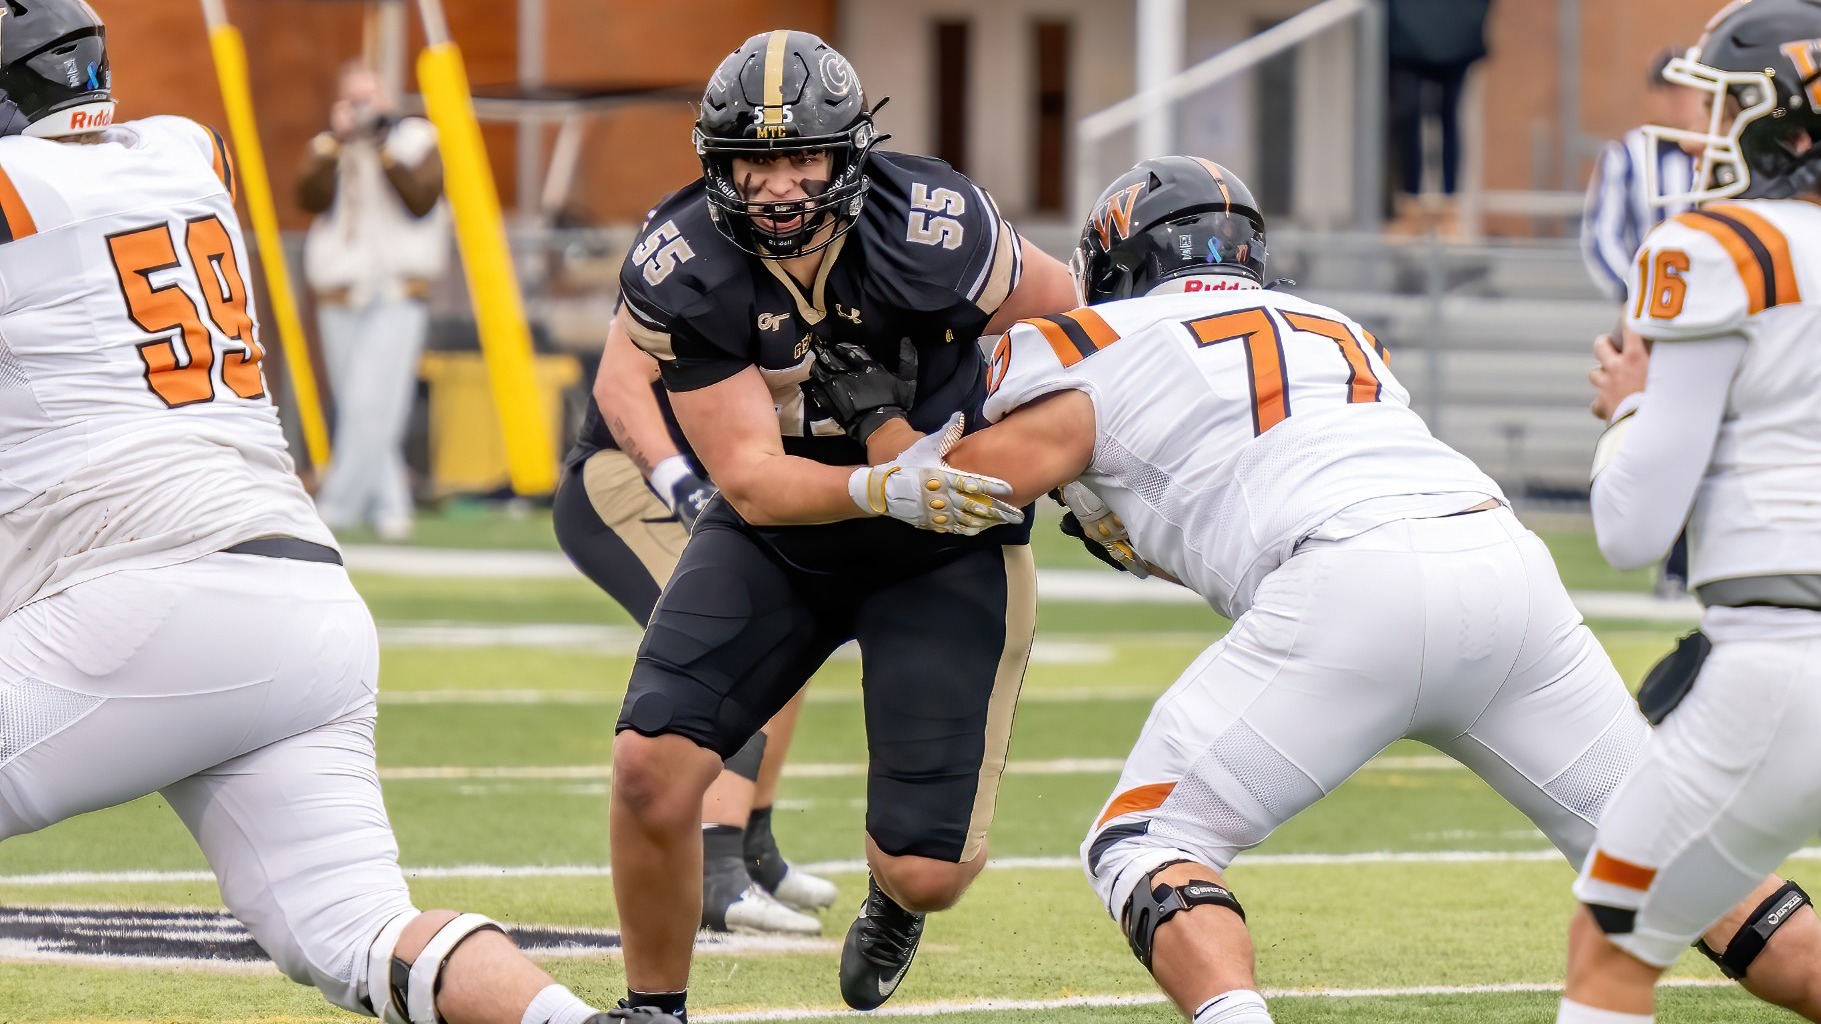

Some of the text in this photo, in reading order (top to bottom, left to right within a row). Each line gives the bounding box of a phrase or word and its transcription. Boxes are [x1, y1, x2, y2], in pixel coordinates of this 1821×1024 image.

[905, 182, 966, 251] 55
[1093, 181, 1146, 254] W
[631, 219, 696, 287] 55
[1184, 279, 1260, 293] Ridd
[1634, 248, 1690, 320] 16
[104, 213, 266, 410] 59
[1180, 305, 1383, 439] 77
